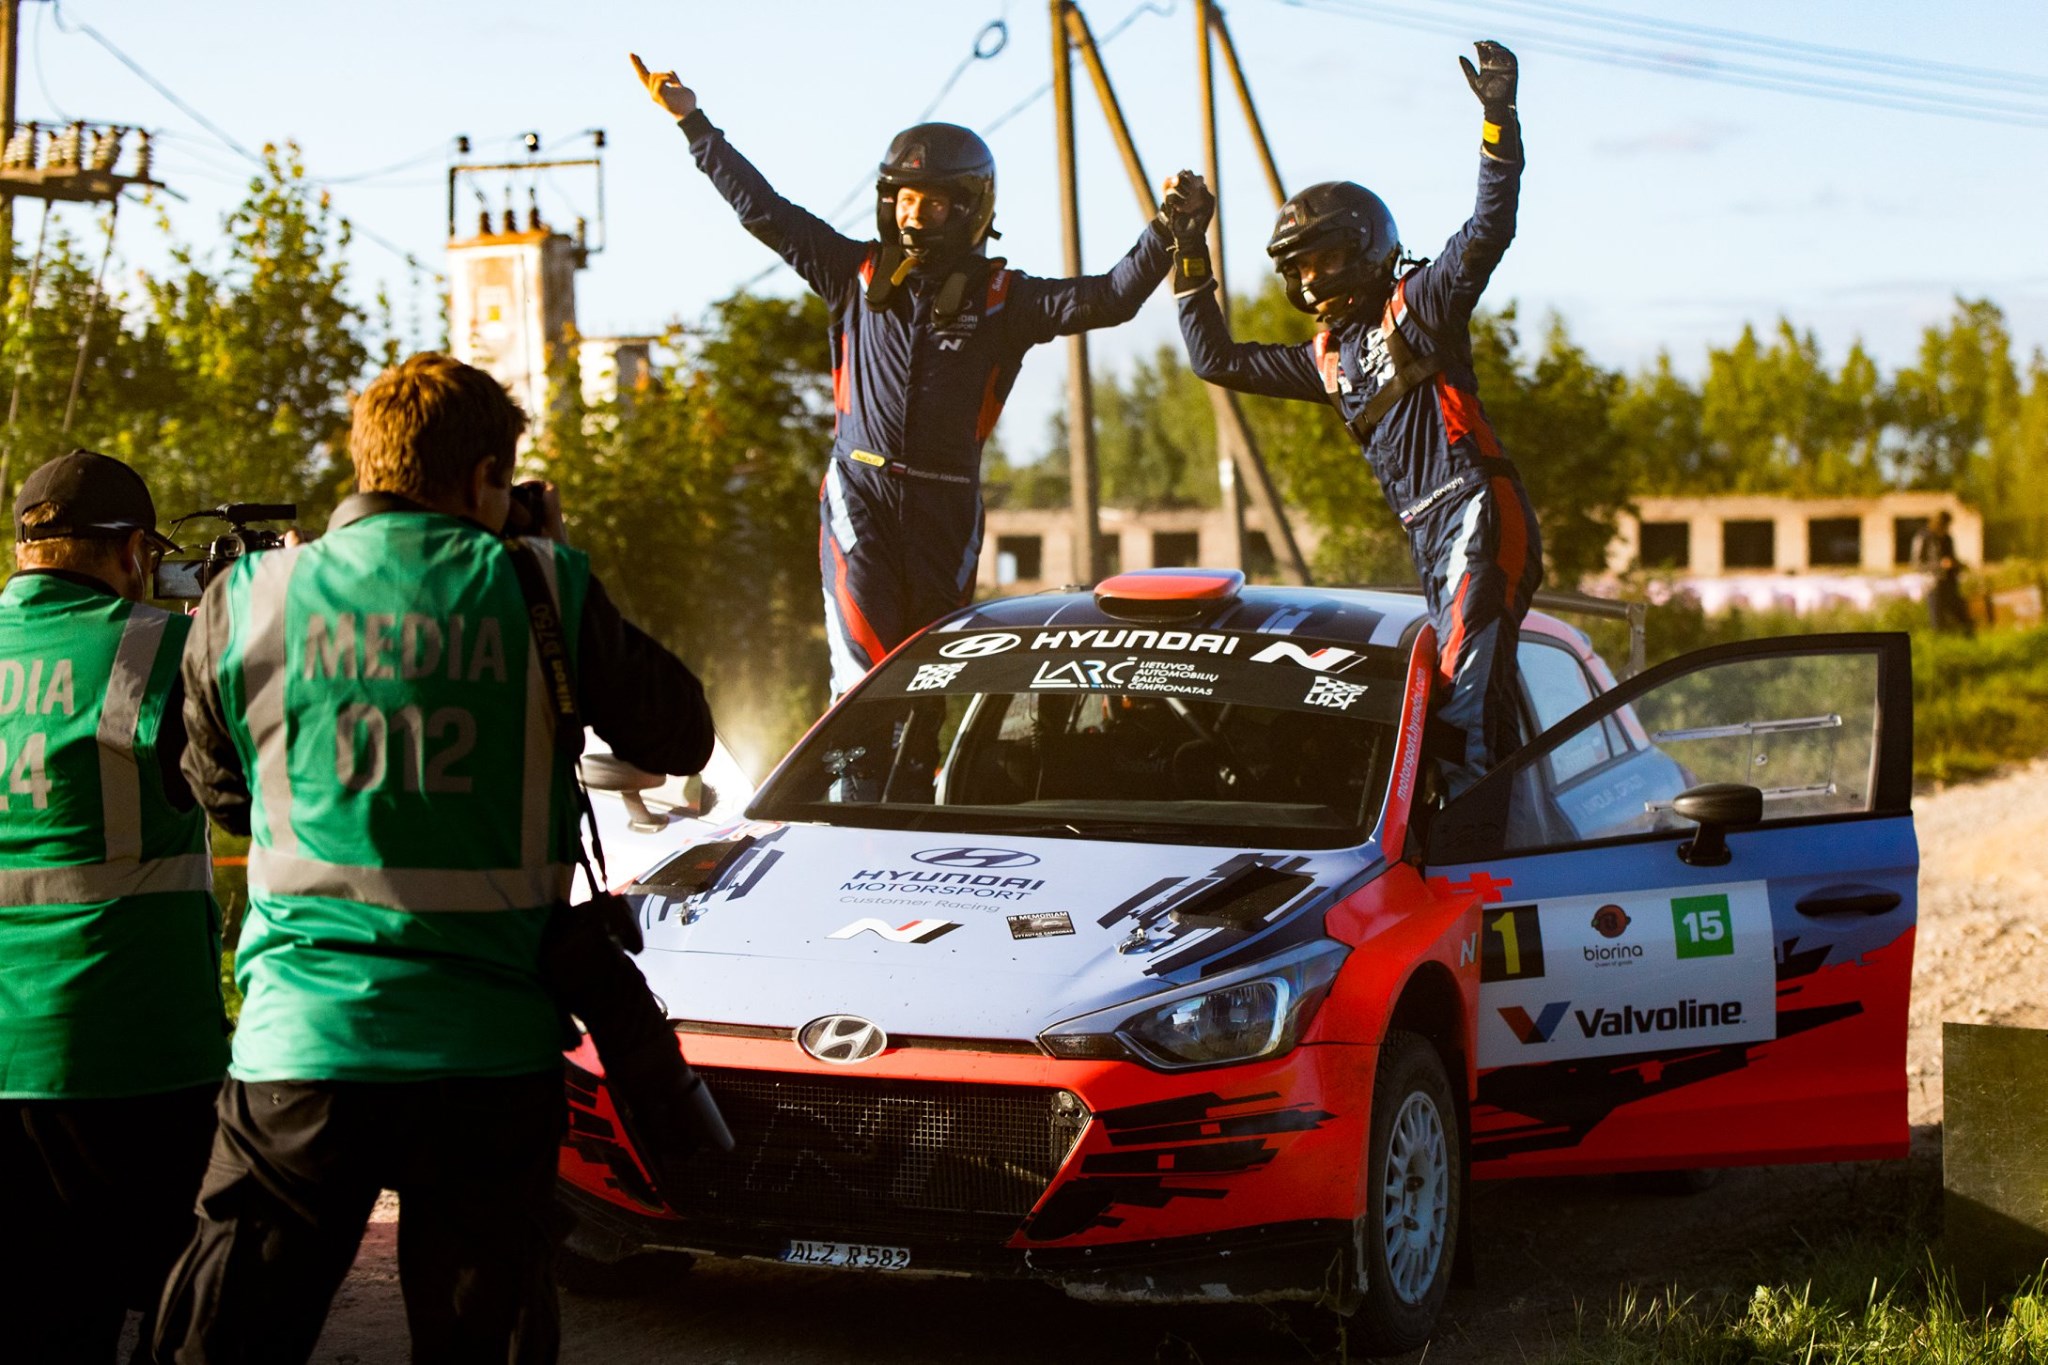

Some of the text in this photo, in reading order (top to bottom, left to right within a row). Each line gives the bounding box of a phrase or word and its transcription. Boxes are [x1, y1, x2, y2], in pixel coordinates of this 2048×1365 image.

[304, 612, 508, 682] MEDIA
[1030, 629, 1240, 655] HYUNDAI
[1029, 656, 1138, 689] LARČ
[1134, 668, 1219, 683] AUTOMOBILIŲ
[1139, 661, 1196, 672] LIETUVOS
[0, 658, 75, 716] DIA
[1303, 691, 1363, 711] LASF
[1396, 667, 1426, 801] motorsport.hyundai.com
[335, 703, 478, 794] 012
[0, 732, 53, 810] 4
[839, 882, 1034, 901] MOTORSPORT
[851, 869, 1046, 891] HYUNDAI
[838, 896, 1001, 913] Customer Racing
[1019, 911, 1068, 921] MEMORIAM
[1682, 910, 1724, 943] 15
[1491, 911, 1521, 975] 1
[1583, 943, 1644, 961] biorina
[1574, 998, 1743, 1039] Valvoline
[790, 1243, 909, 1267] ALZ R 582
